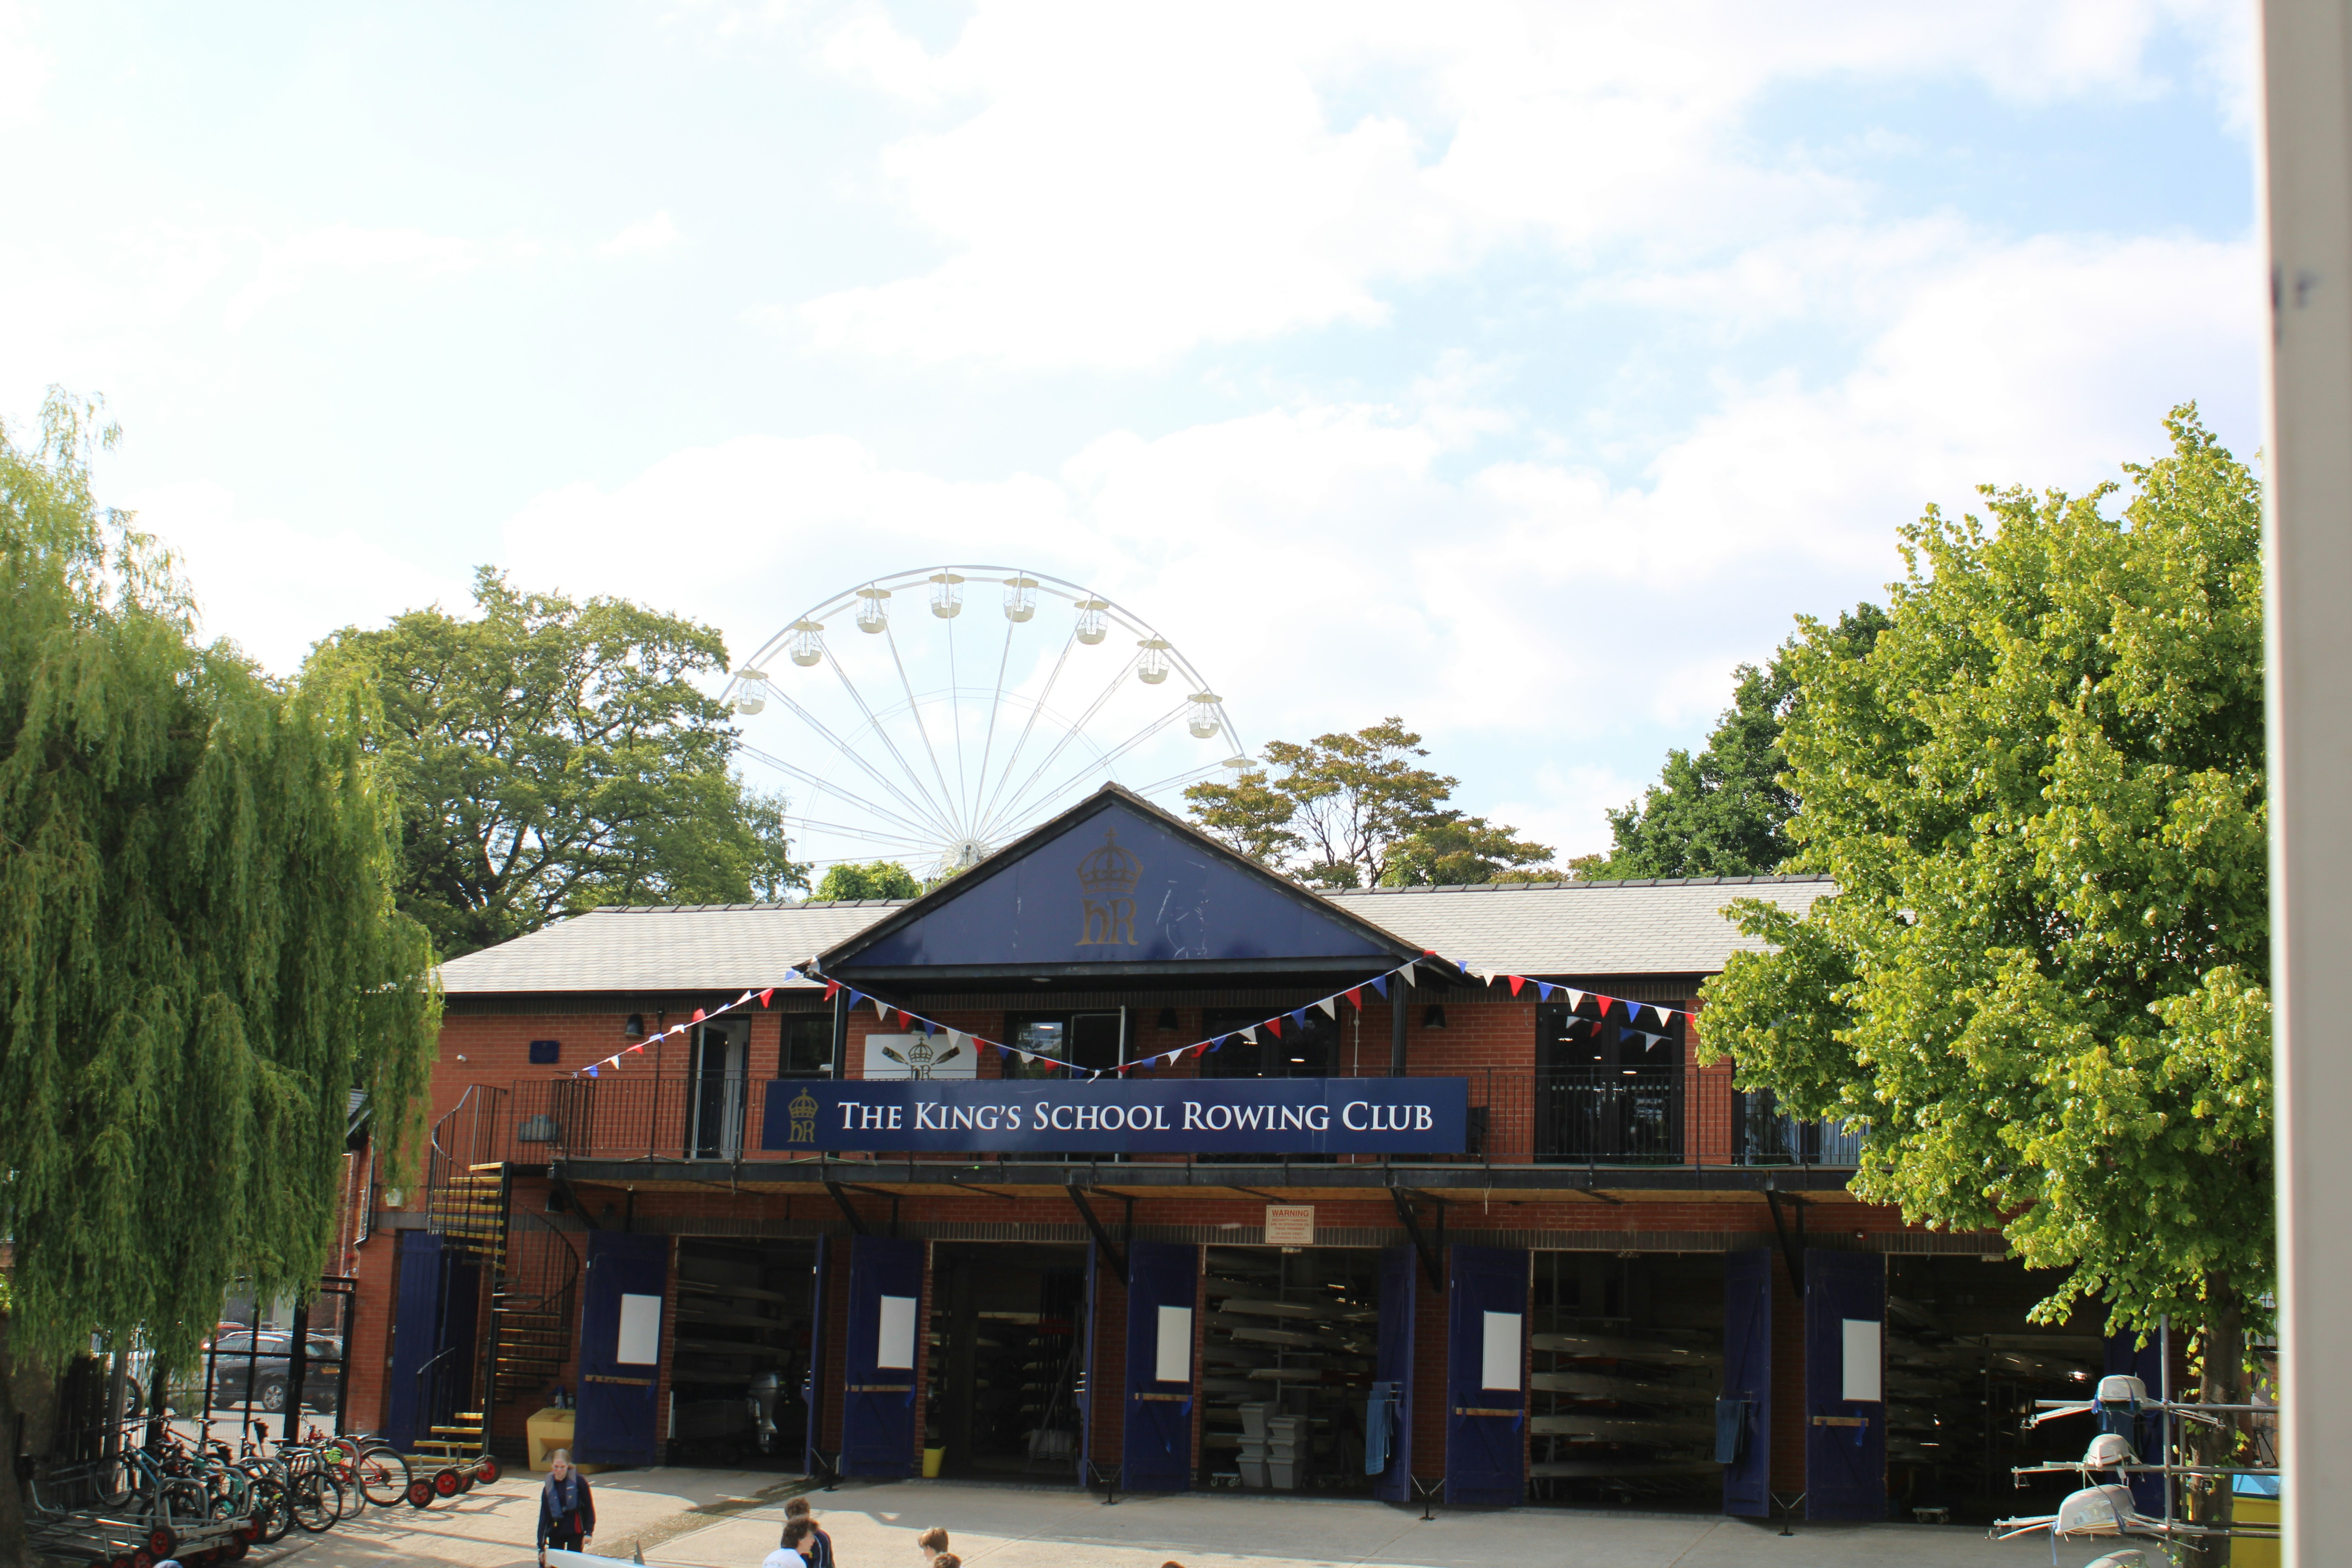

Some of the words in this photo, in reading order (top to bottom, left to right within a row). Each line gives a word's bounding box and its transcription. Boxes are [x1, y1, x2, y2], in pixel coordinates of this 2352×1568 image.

[838, 1102, 902, 1129] THE
[1033, 1102, 1170, 1130] SCHOOL
[1182, 1102, 1330, 1130] ROWING
[1343, 1101, 1433, 1130] CLUB
